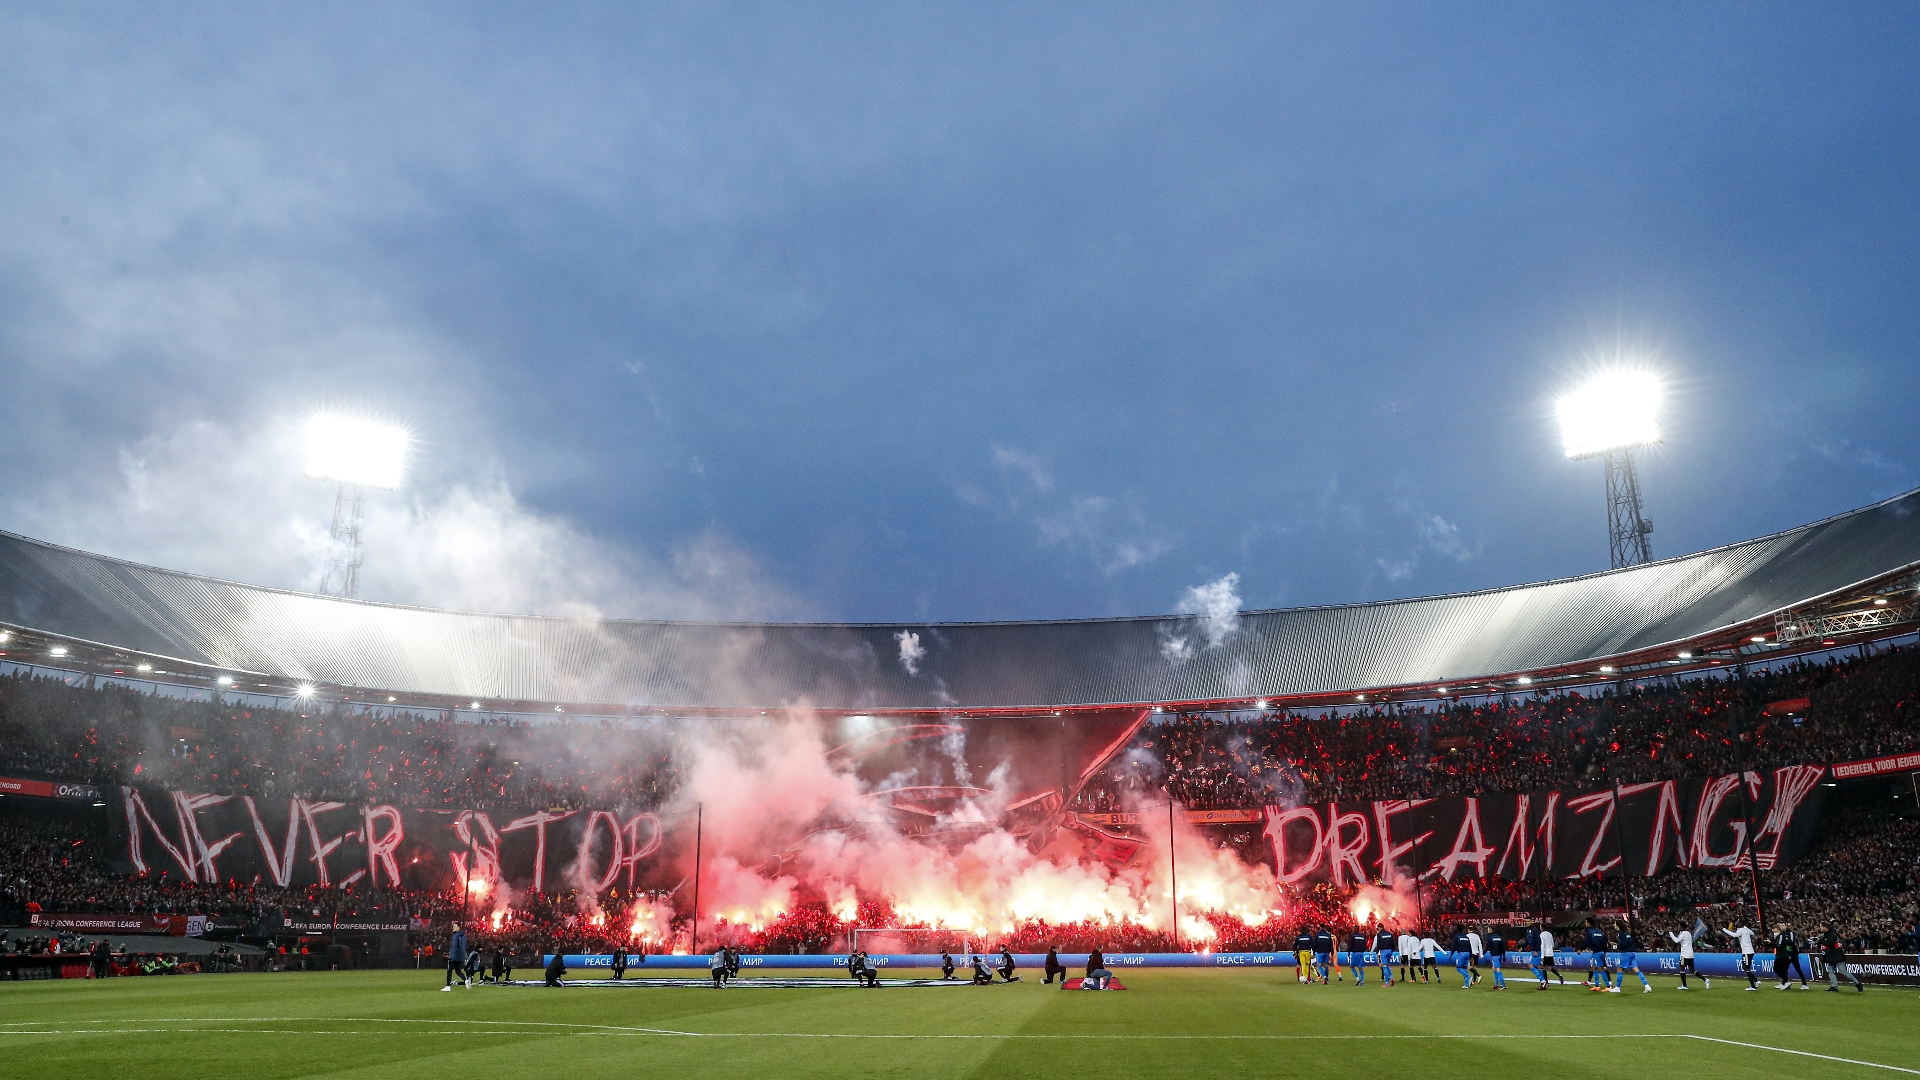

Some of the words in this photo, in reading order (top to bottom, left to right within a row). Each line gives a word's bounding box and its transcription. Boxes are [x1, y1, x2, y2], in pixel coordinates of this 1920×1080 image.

[1836, 763, 1876, 776] IEDEREEN,
[1875, 759, 1897, 771] VOOR
[121, 785, 405, 889] NEVER
[449, 808, 664, 894] STOP
[75, 920, 116, 928] CONFERENCE
[117, 920, 142, 928] LEAGUE
[584, 957, 611, 966] PEACE
[742, 957, 763, 966] МИР
[1123, 957, 1144, 965] МИР
[1216, 956, 1245, 964] PEACE
[1253, 956, 1274, 964] МИР
